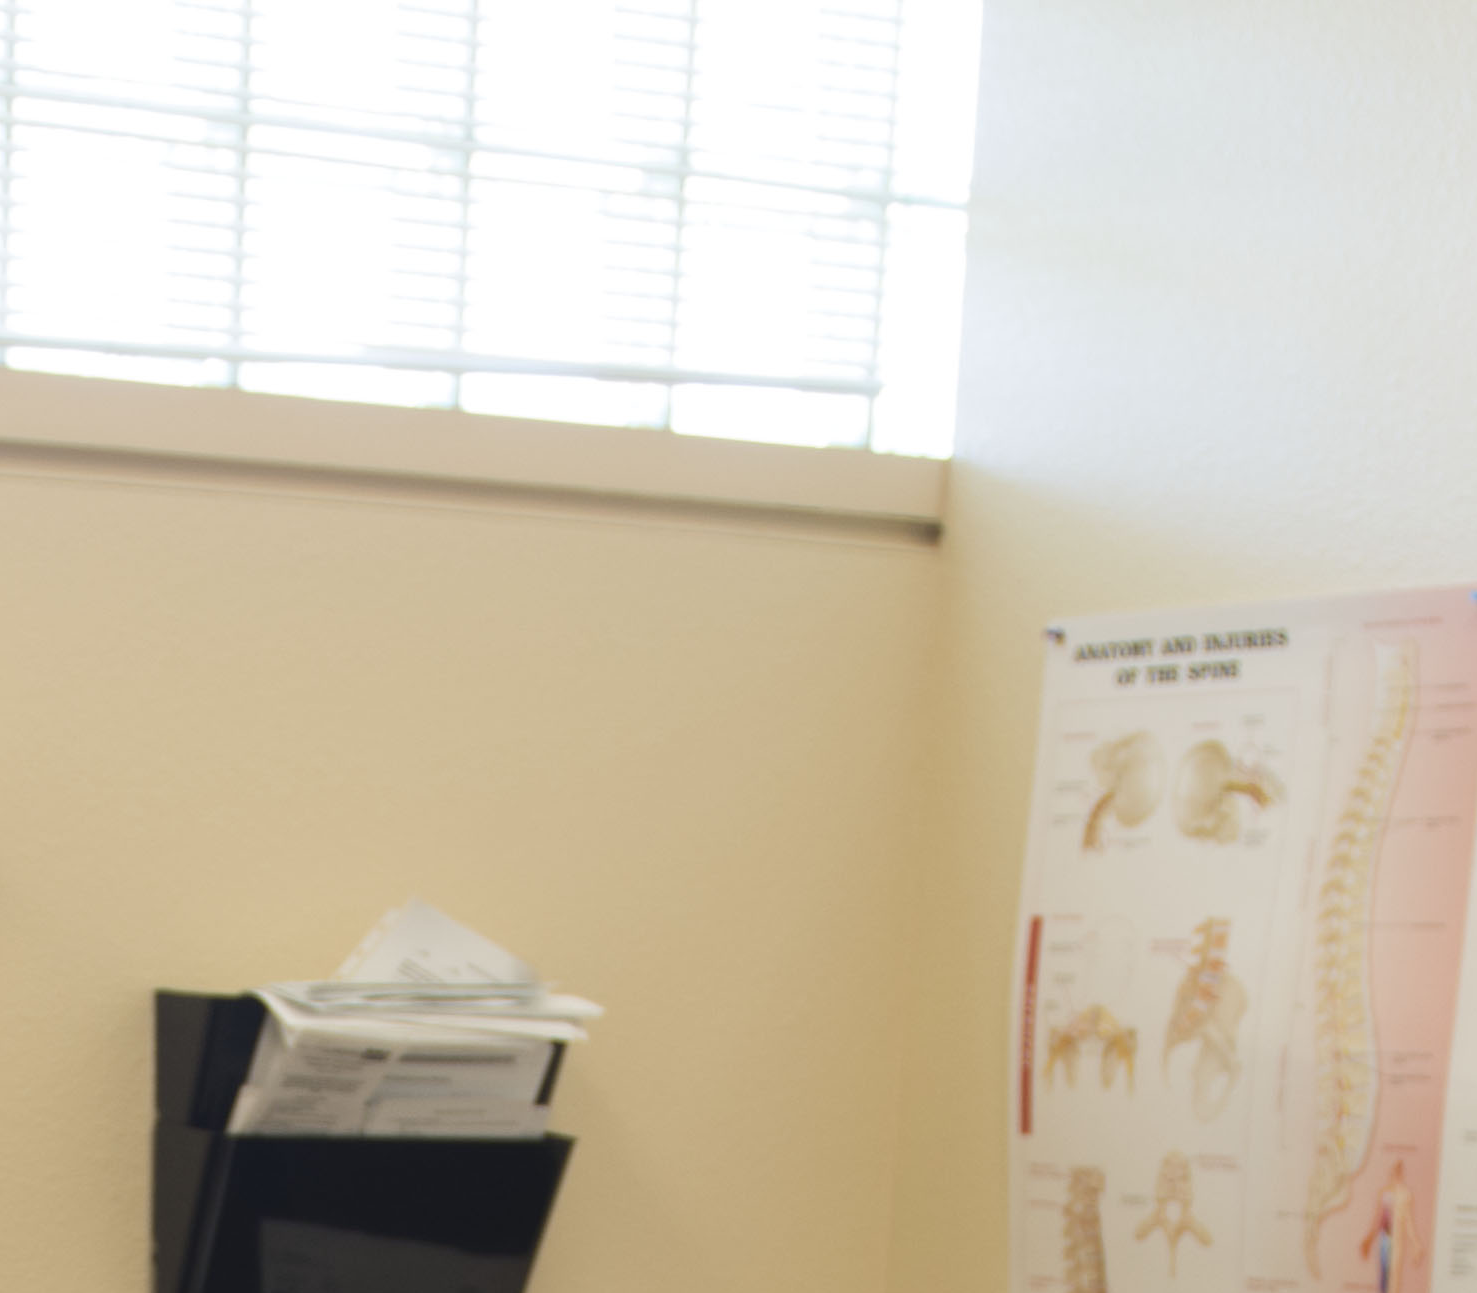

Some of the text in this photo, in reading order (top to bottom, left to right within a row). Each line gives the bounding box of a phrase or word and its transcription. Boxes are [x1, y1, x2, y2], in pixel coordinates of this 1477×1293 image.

[1073, 627, 1289, 663] ANATOMY AND INJURIES
[1116, 659, 1241, 686] OF THE SPINE
